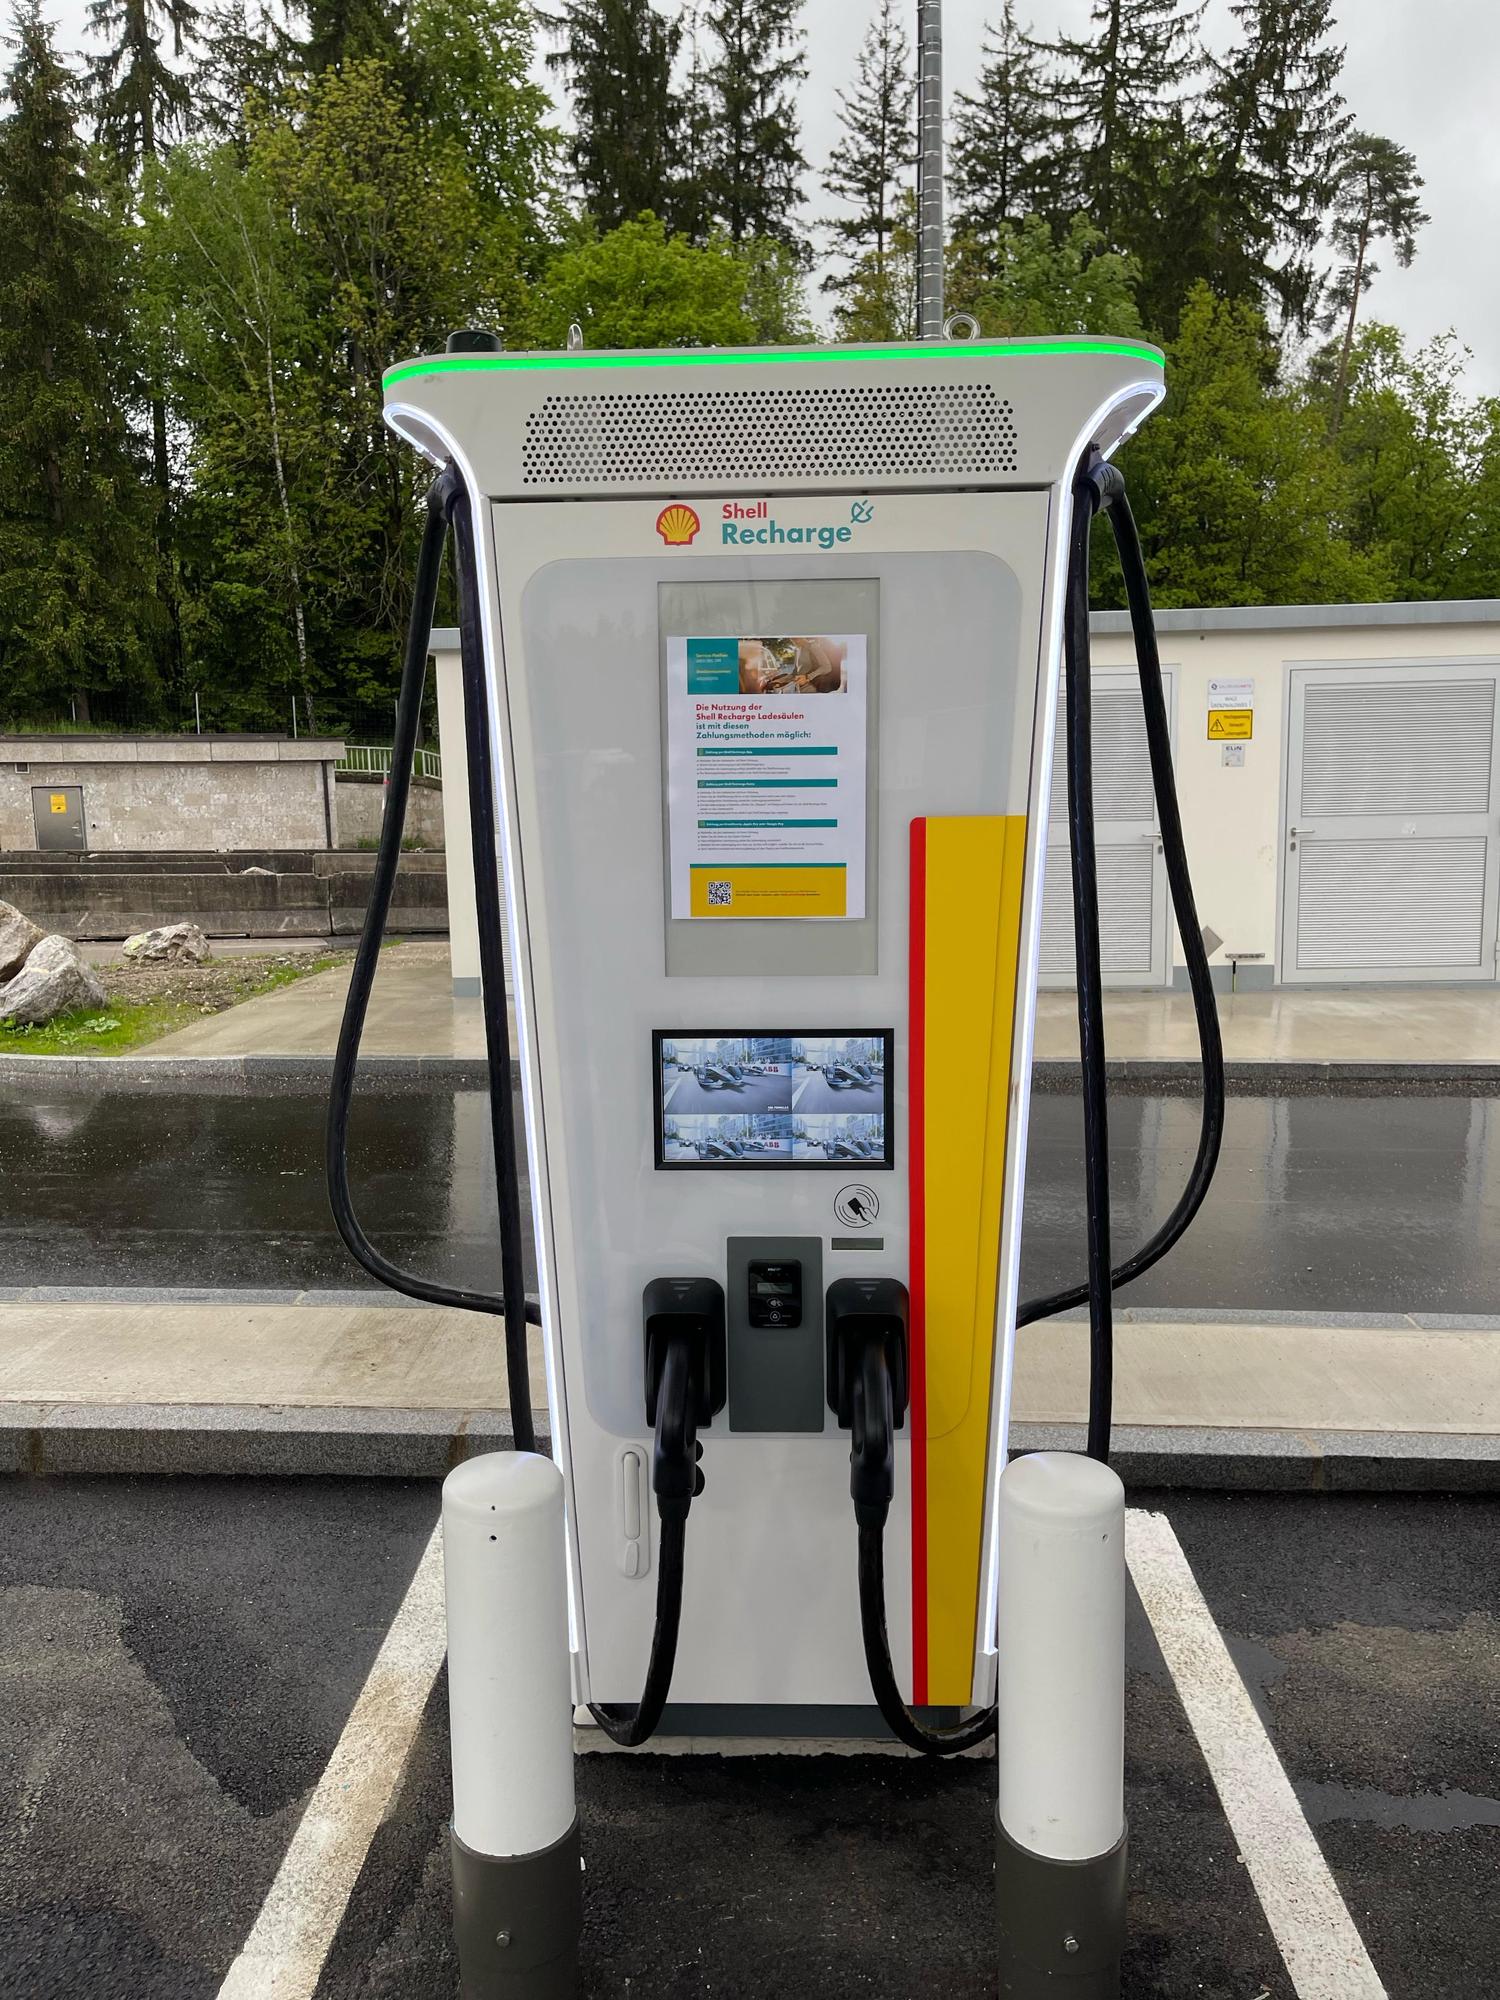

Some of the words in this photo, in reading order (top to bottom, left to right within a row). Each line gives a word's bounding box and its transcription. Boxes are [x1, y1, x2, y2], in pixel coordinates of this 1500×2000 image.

[722, 502, 767, 519] Shell
[722, 520, 852, 549] Recharge
[711, 704, 746, 712] Nutzung
[748, 703, 762, 711] der
[718, 713, 756, 721] Recharge
[758, 712, 804, 720] Ladesäulen
[723, 722, 749, 730] diesen
[696, 731, 775, 740] Zahlungsmethoden
[777, 731, 811, 740] möglich:
